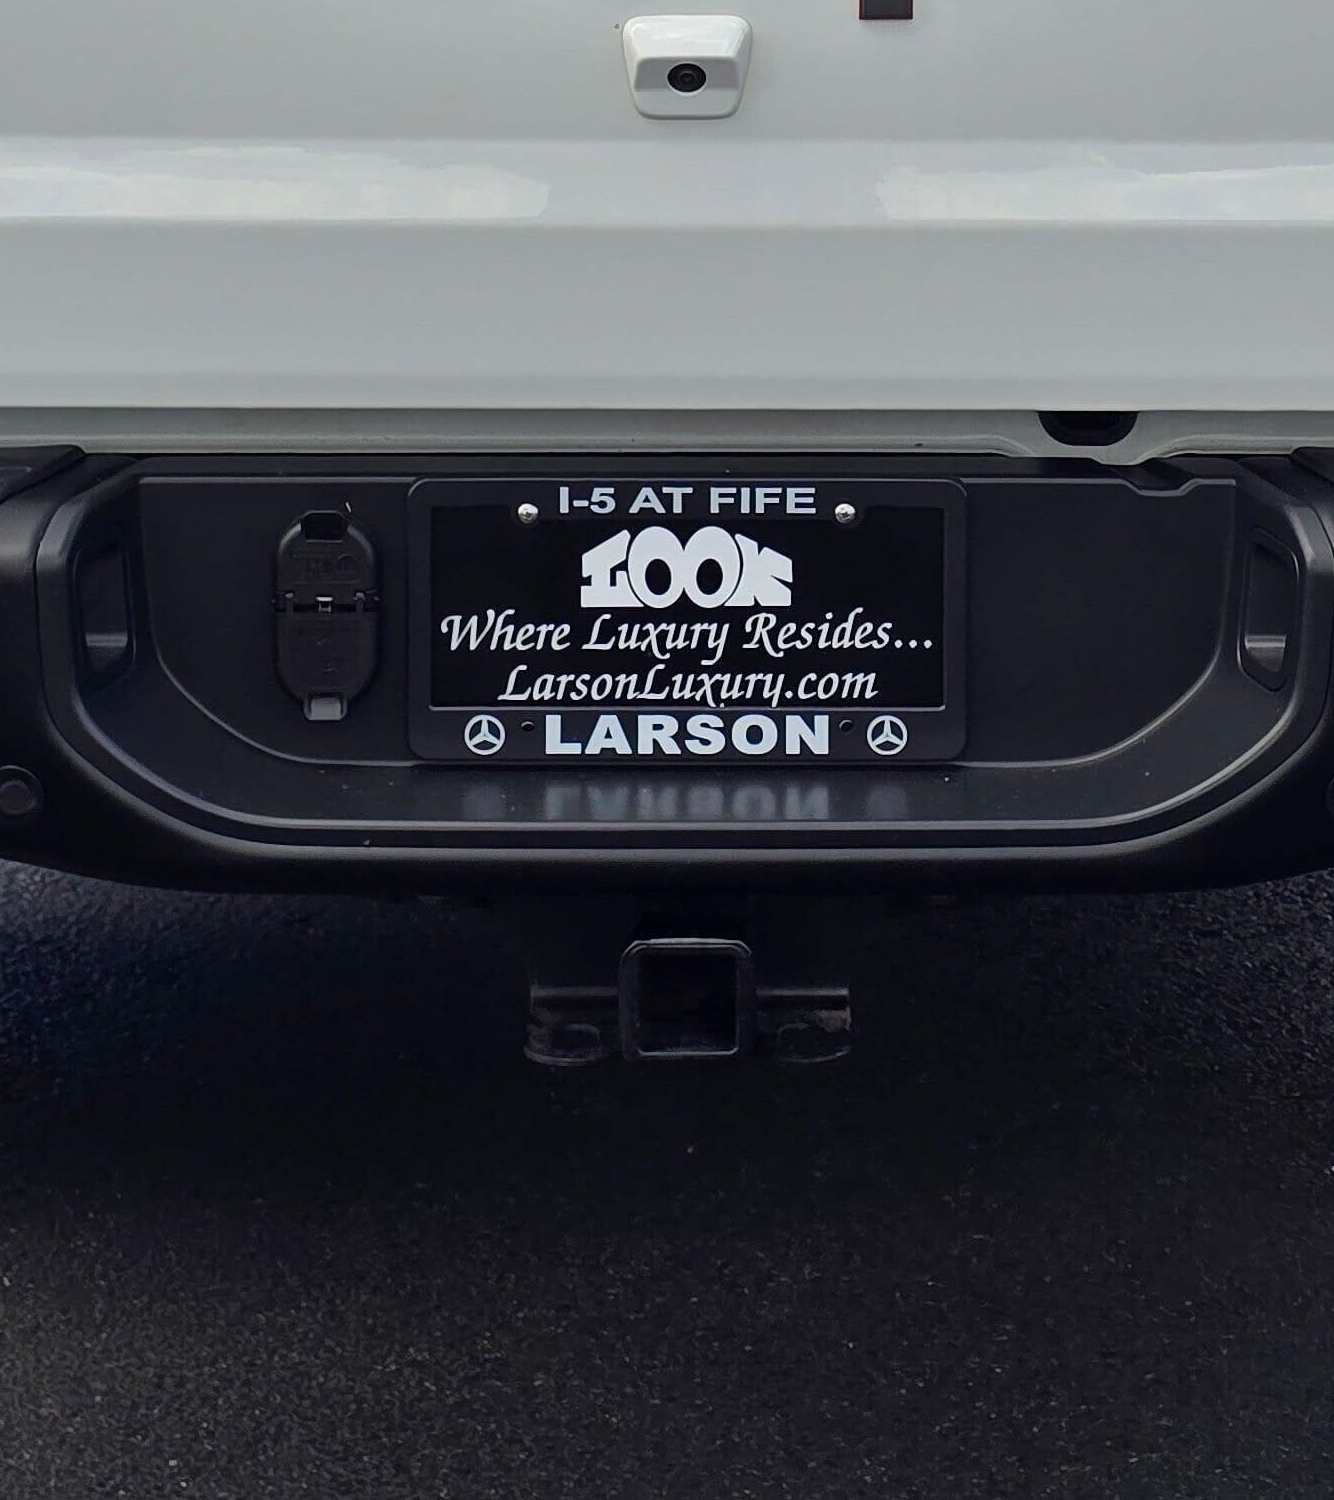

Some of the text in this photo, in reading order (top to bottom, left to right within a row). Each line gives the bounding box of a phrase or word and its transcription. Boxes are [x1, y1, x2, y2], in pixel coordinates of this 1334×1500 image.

[559, 486, 817, 514] I-5 AT FIFE
[440, 606, 934, 666] Where Luxury Resides...
[497, 663, 879, 708] LarsonLuxury.com
[545, 714, 830, 755] LARSON
